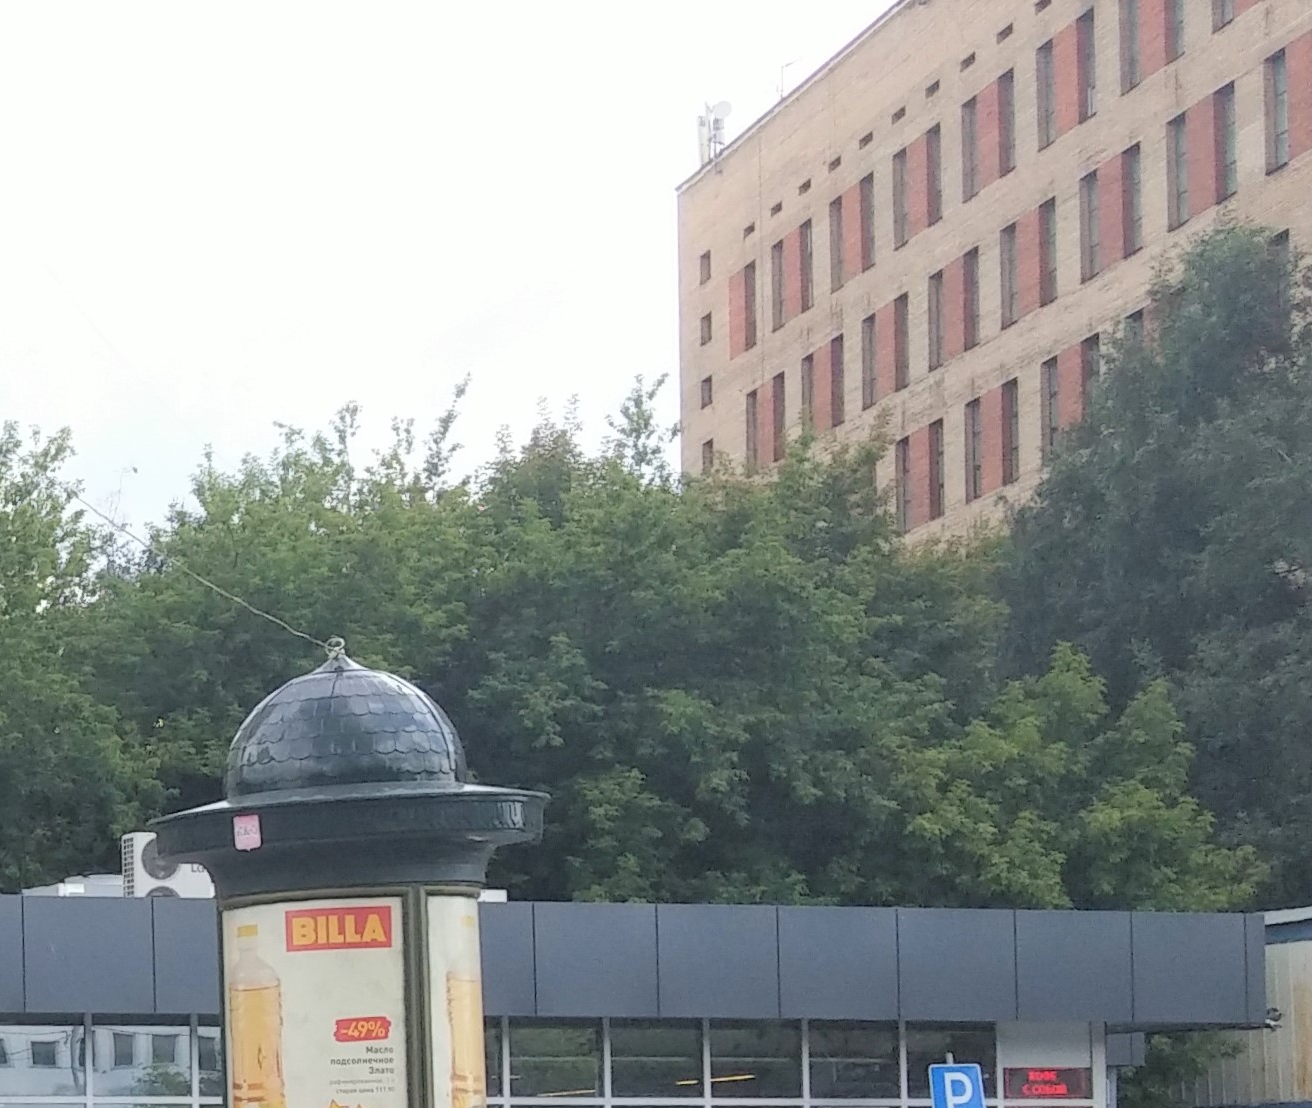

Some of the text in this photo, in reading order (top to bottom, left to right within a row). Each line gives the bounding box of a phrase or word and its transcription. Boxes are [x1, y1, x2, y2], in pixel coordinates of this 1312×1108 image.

[291, 913, 387, 946] BILLA
[340, 1020, 386, 1038] -49%
[365, 1046, 394, 1054] Масло
[330, 1057, 394, 1066] подсолнечное
[368, 1066, 395, 1075] Злато
